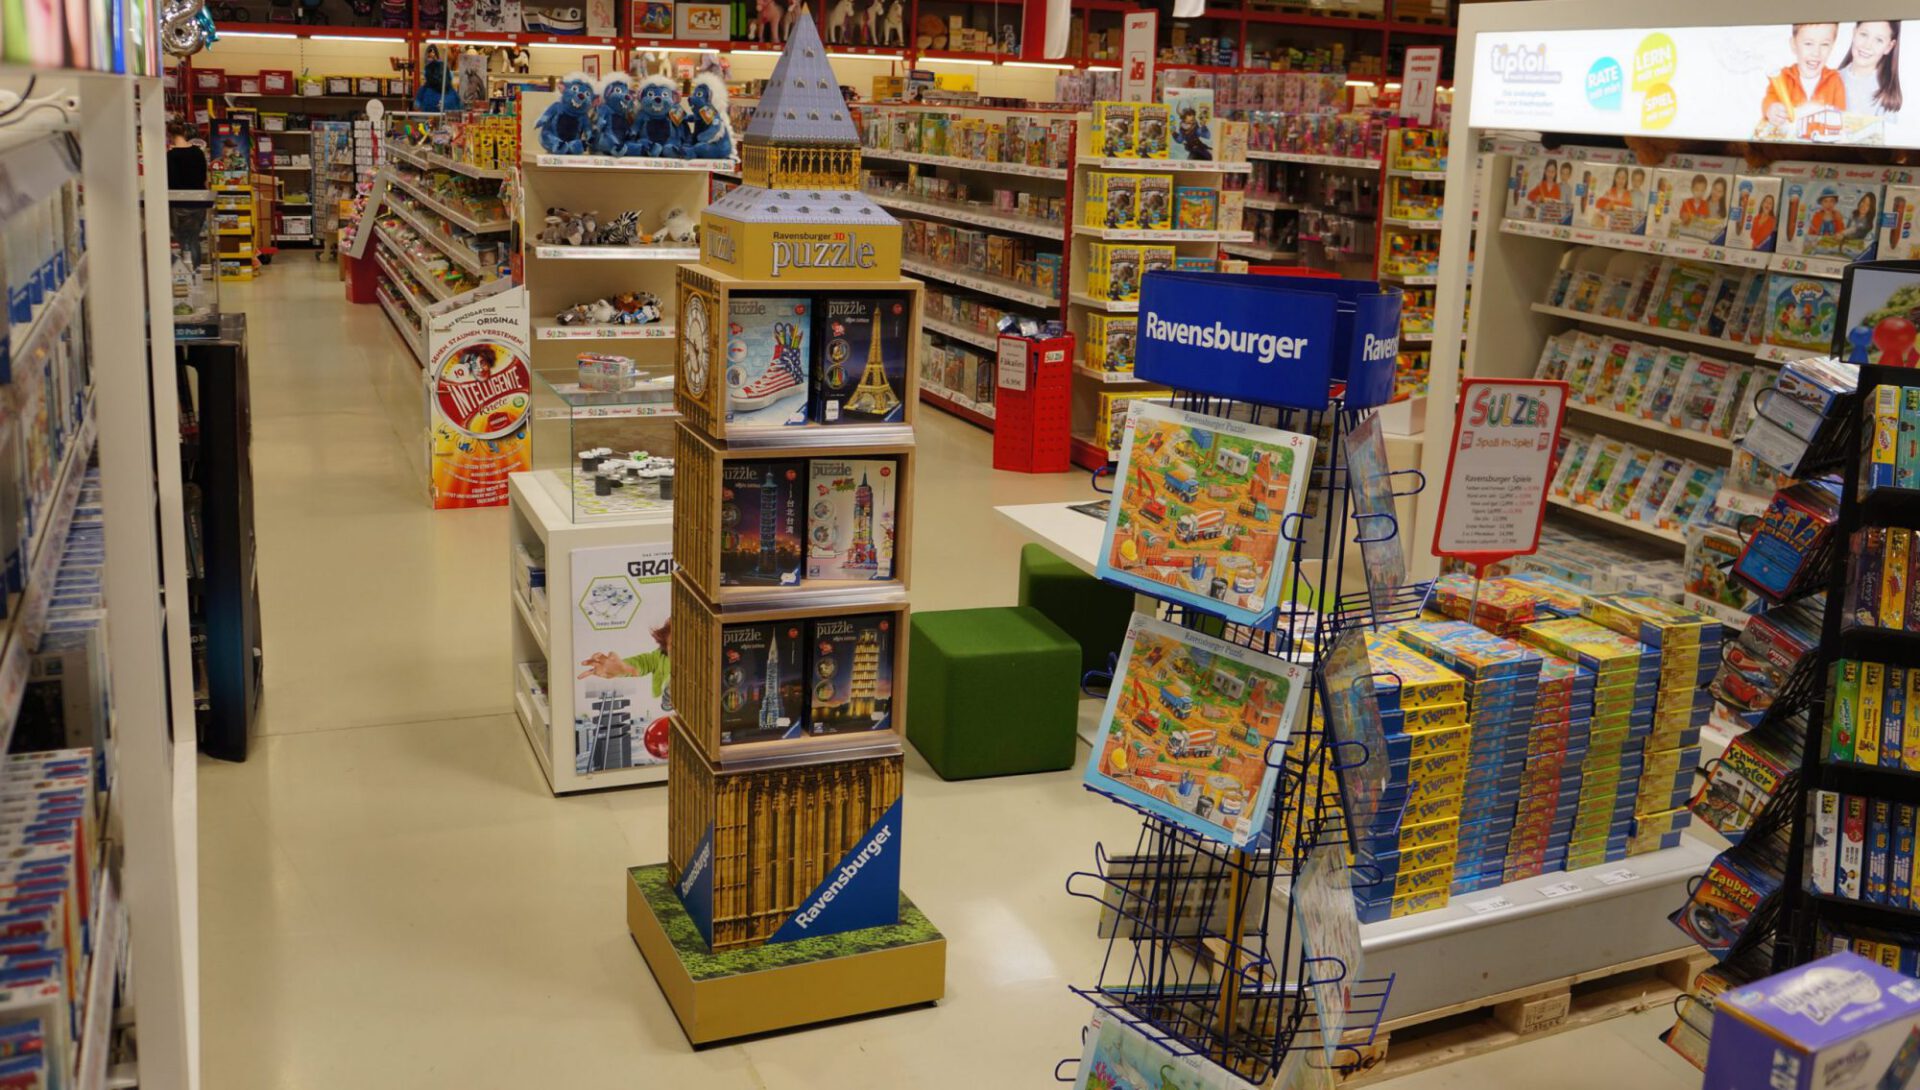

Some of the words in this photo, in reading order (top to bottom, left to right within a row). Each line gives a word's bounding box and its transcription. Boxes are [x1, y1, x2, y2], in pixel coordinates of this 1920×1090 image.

[1490, 43, 1545, 80] tiptoi
[1635, 46, 1671, 71] LERN
[1587, 66, 1619, 88] RATE
[773, 231, 831, 241] Ravensburger
[833, 231, 845, 241] 3D
[770, 232, 876, 278] puzzle
[829, 302, 866, 317] puzzle
[476, 316, 519, 326] ORIGINAL
[1146, 311, 1308, 364] Ravensburger
[454, 368, 465, 378] IQ
[447, 366, 522, 419] INTELLIGENTE
[1469, 387, 1550, 428] SULZER
[1290, 436, 1304, 447] 3+
[812, 463, 851, 479] puzzle
[1465, 474, 1511, 485] Ravensburger
[723, 628, 761, 646] puzzle
[816, 621, 854, 639] puzzle
[1287, 667, 1301, 679] 3+
[1728, 747, 1781, 779] Schwarzer
[1735, 759, 1772, 786] Peter
[794, 824, 893, 929] Ravensburger
[1708, 866, 1755, 900] Zauber
